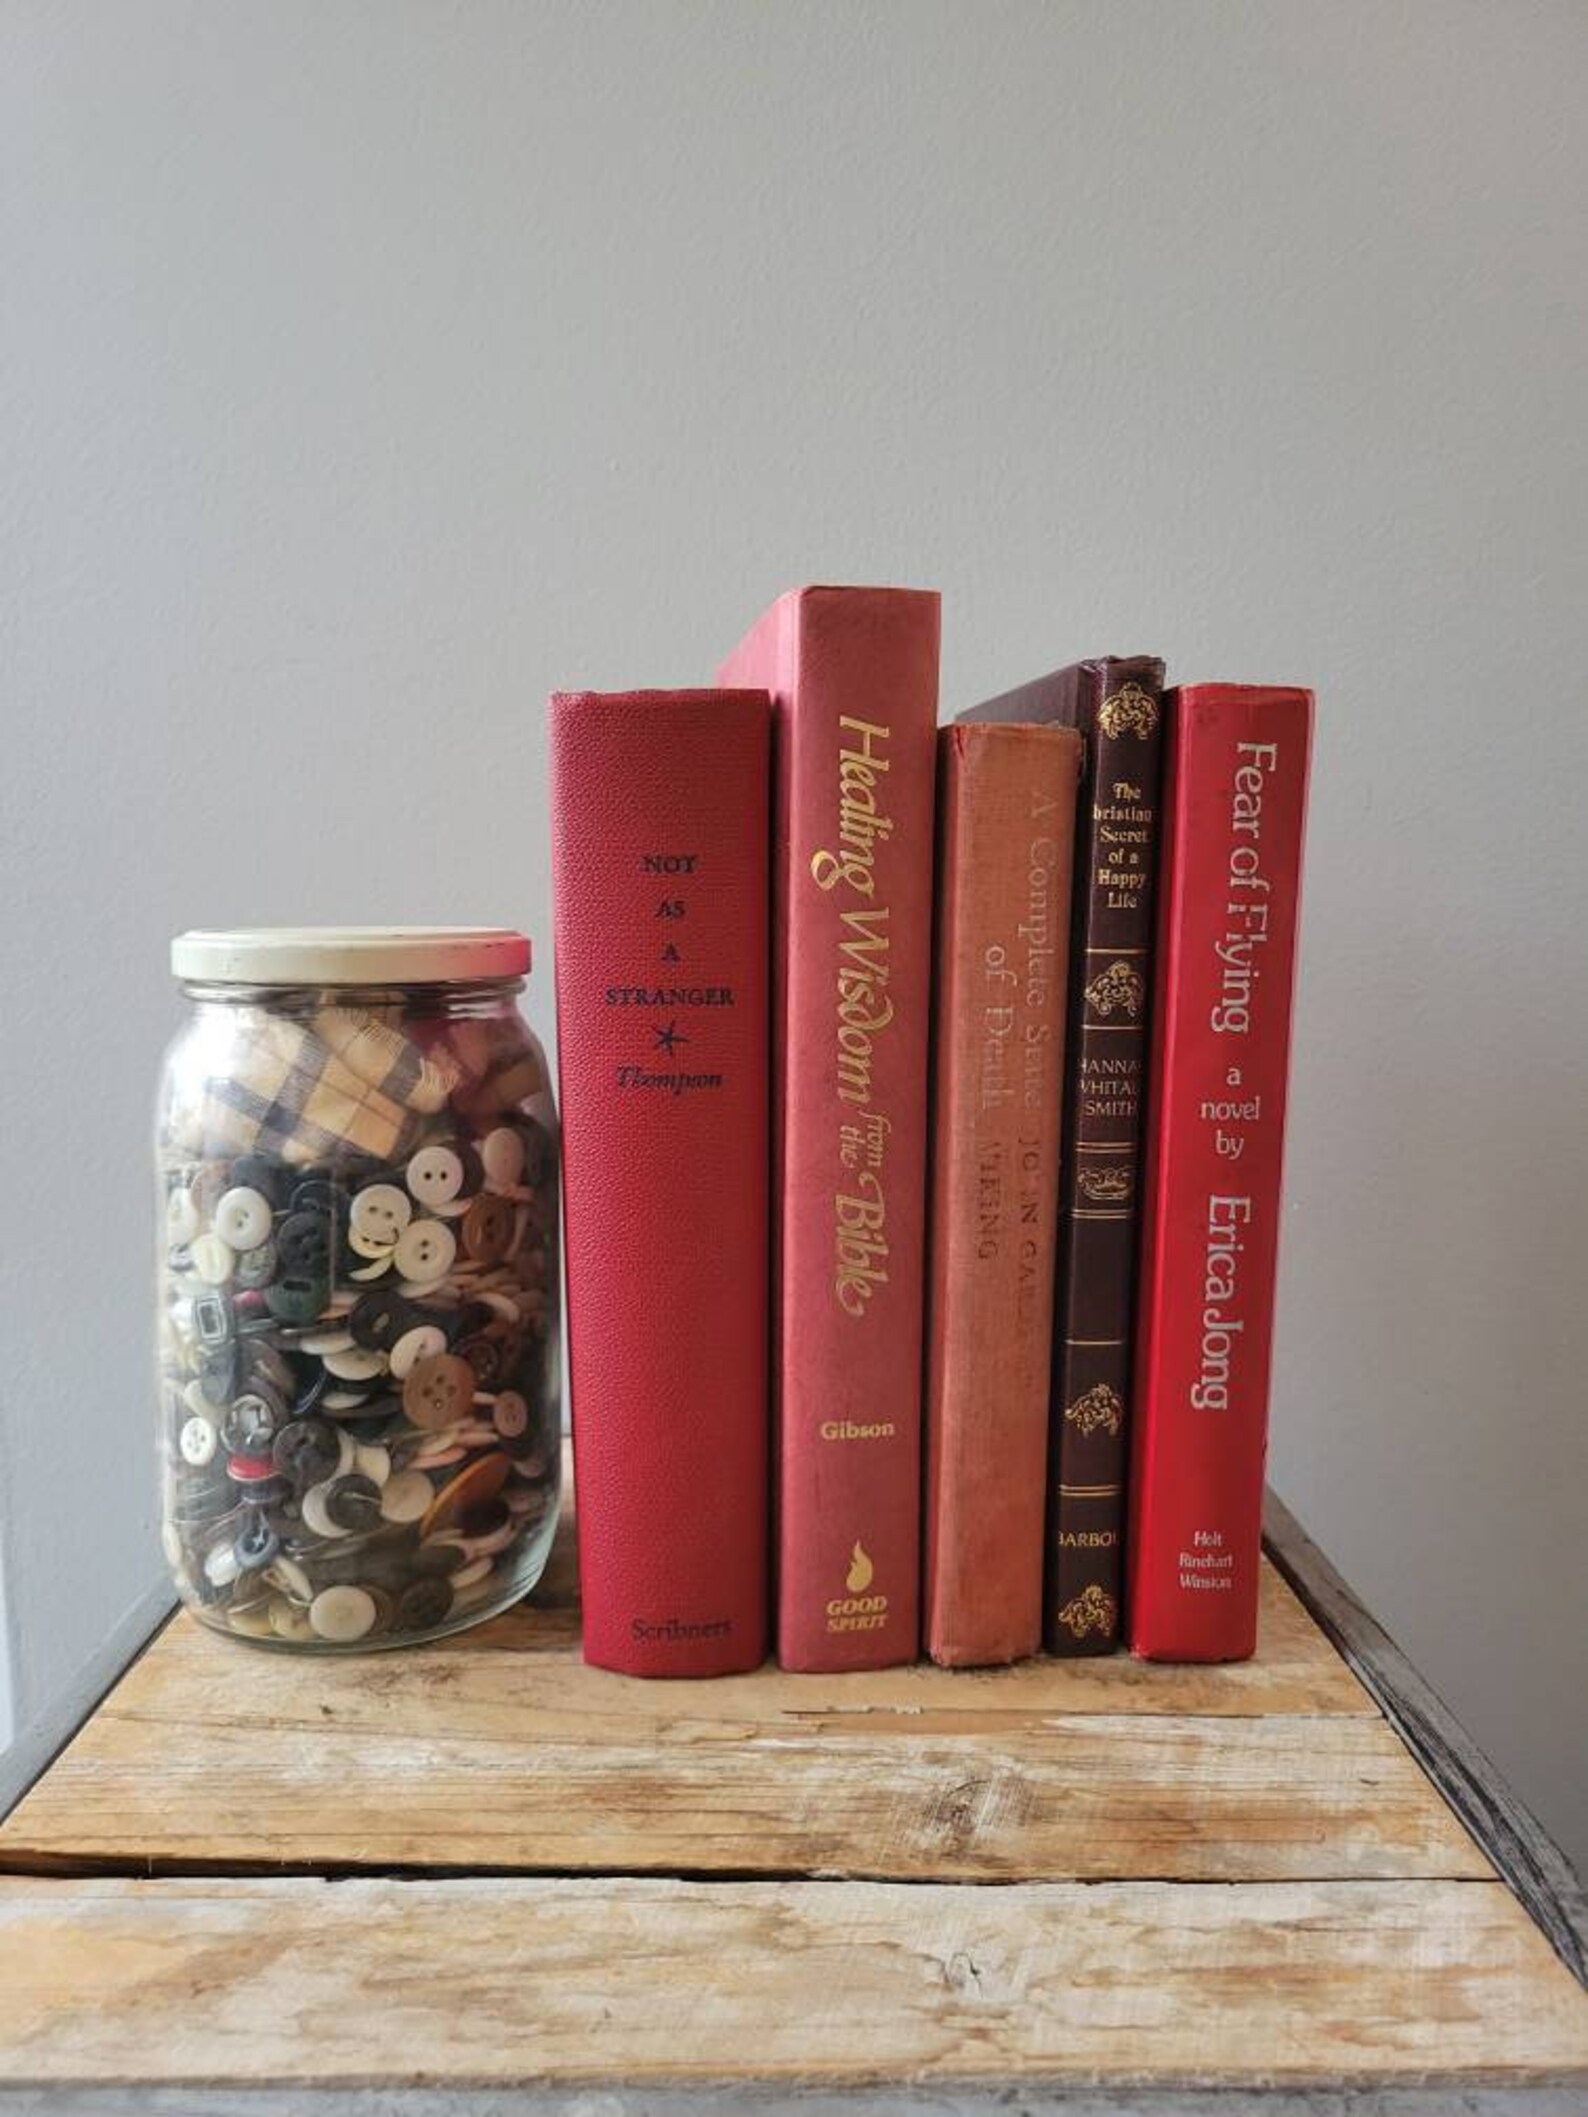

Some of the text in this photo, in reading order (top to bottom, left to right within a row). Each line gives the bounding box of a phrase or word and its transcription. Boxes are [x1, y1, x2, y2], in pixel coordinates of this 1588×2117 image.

[1112, 782, 1142, 800] The
[1030, 790, 1059, 818] A
[1093, 803, 1152, 822] hristian
[1099, 825, 1149, 843] Secret
[643, 854, 697, 873] NOT
[1108, 848, 1139, 864] of a
[1097, 868, 1146, 889] Happy
[1210, 742, 1278, 1034] Fear of Flying
[655, 900, 686, 917] AS
[1107, 891, 1138, 908] Life
[1018, 836, 1057, 1008] Complete
[660, 941, 681, 961] A
[984, 945, 1018, 987] of
[605, 987, 735, 1007] STRANGER
[810, 714, 894, 1318] Healing Wisdom from the Bible
[616, 1066, 724, 1096] Thompson
[1226, 1067, 1242, 1085] a
[1084, 1100, 1138, 1116] SMITH
[1200, 1096, 1261, 1122] novel
[1215, 1129, 1245, 1160] by
[1189, 1194, 1252, 1412] Erica Jong
[820, 1421, 896, 1440] Gibson
[1194, 1530, 1222, 1547] Holt
[826, 1596, 888, 1616] GOOD
[826, 1614, 888, 1633] SPIRIT
